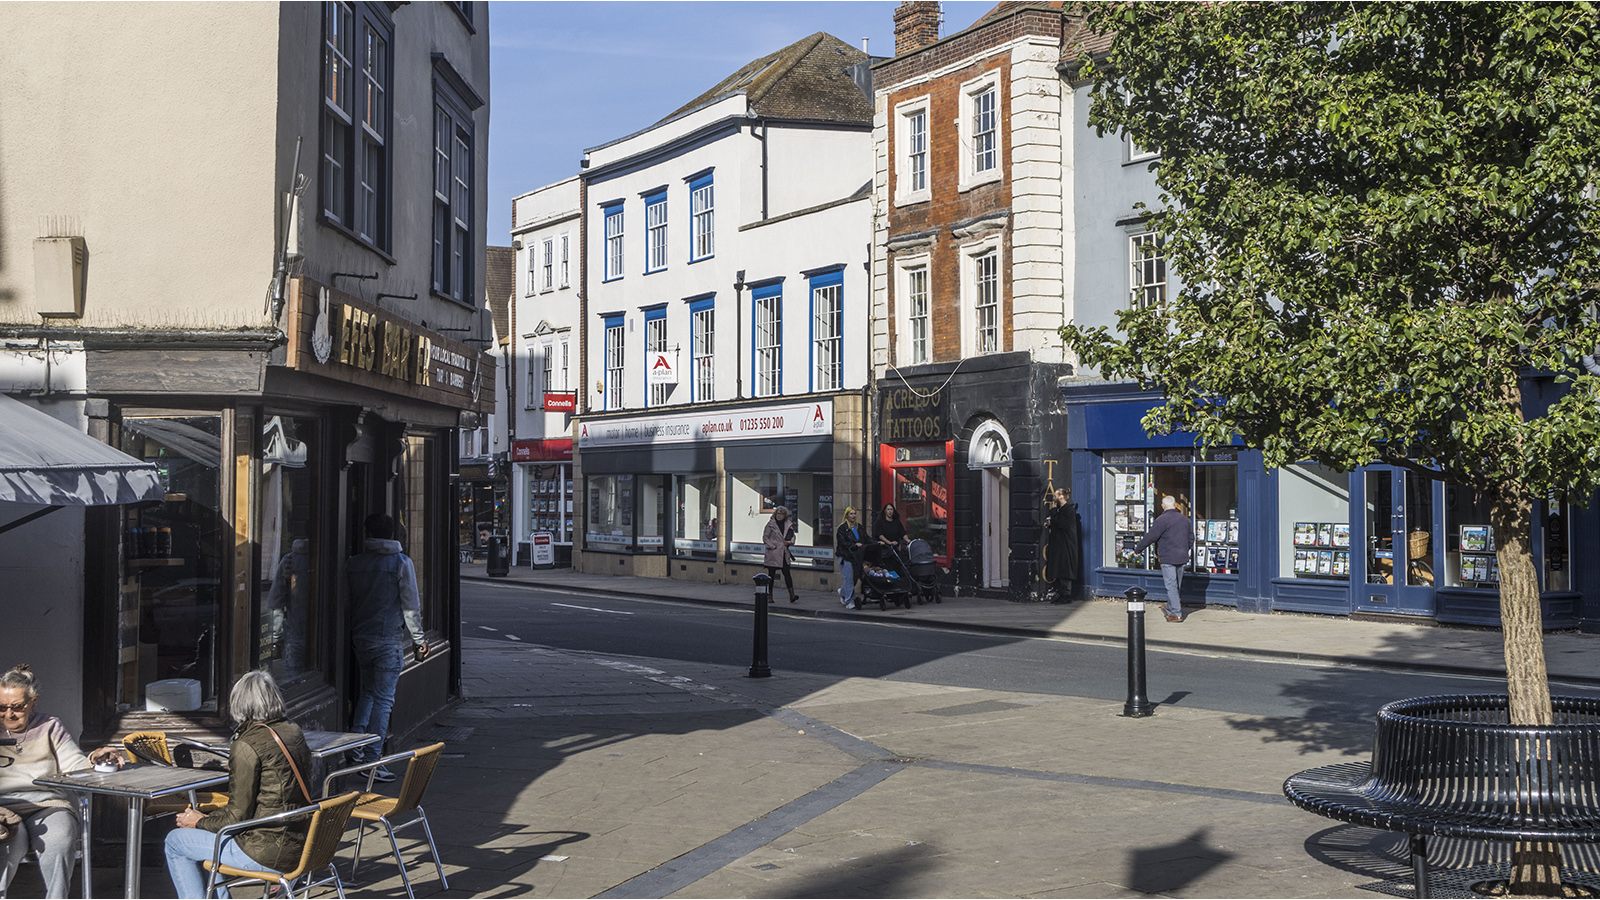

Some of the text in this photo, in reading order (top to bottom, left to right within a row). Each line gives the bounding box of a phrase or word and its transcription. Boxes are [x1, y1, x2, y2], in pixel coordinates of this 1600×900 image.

[340, 303, 377, 372] EFES
[886, 385, 941, 409] ACREEDO
[605, 416, 784, 439] motor home business insurance aplan.co.uk 01235 550 200
[886, 416, 941, 439] TATTOOS
[1162, 453, 1185, 463] lettings
[1214, 452, 1233, 461] sales
